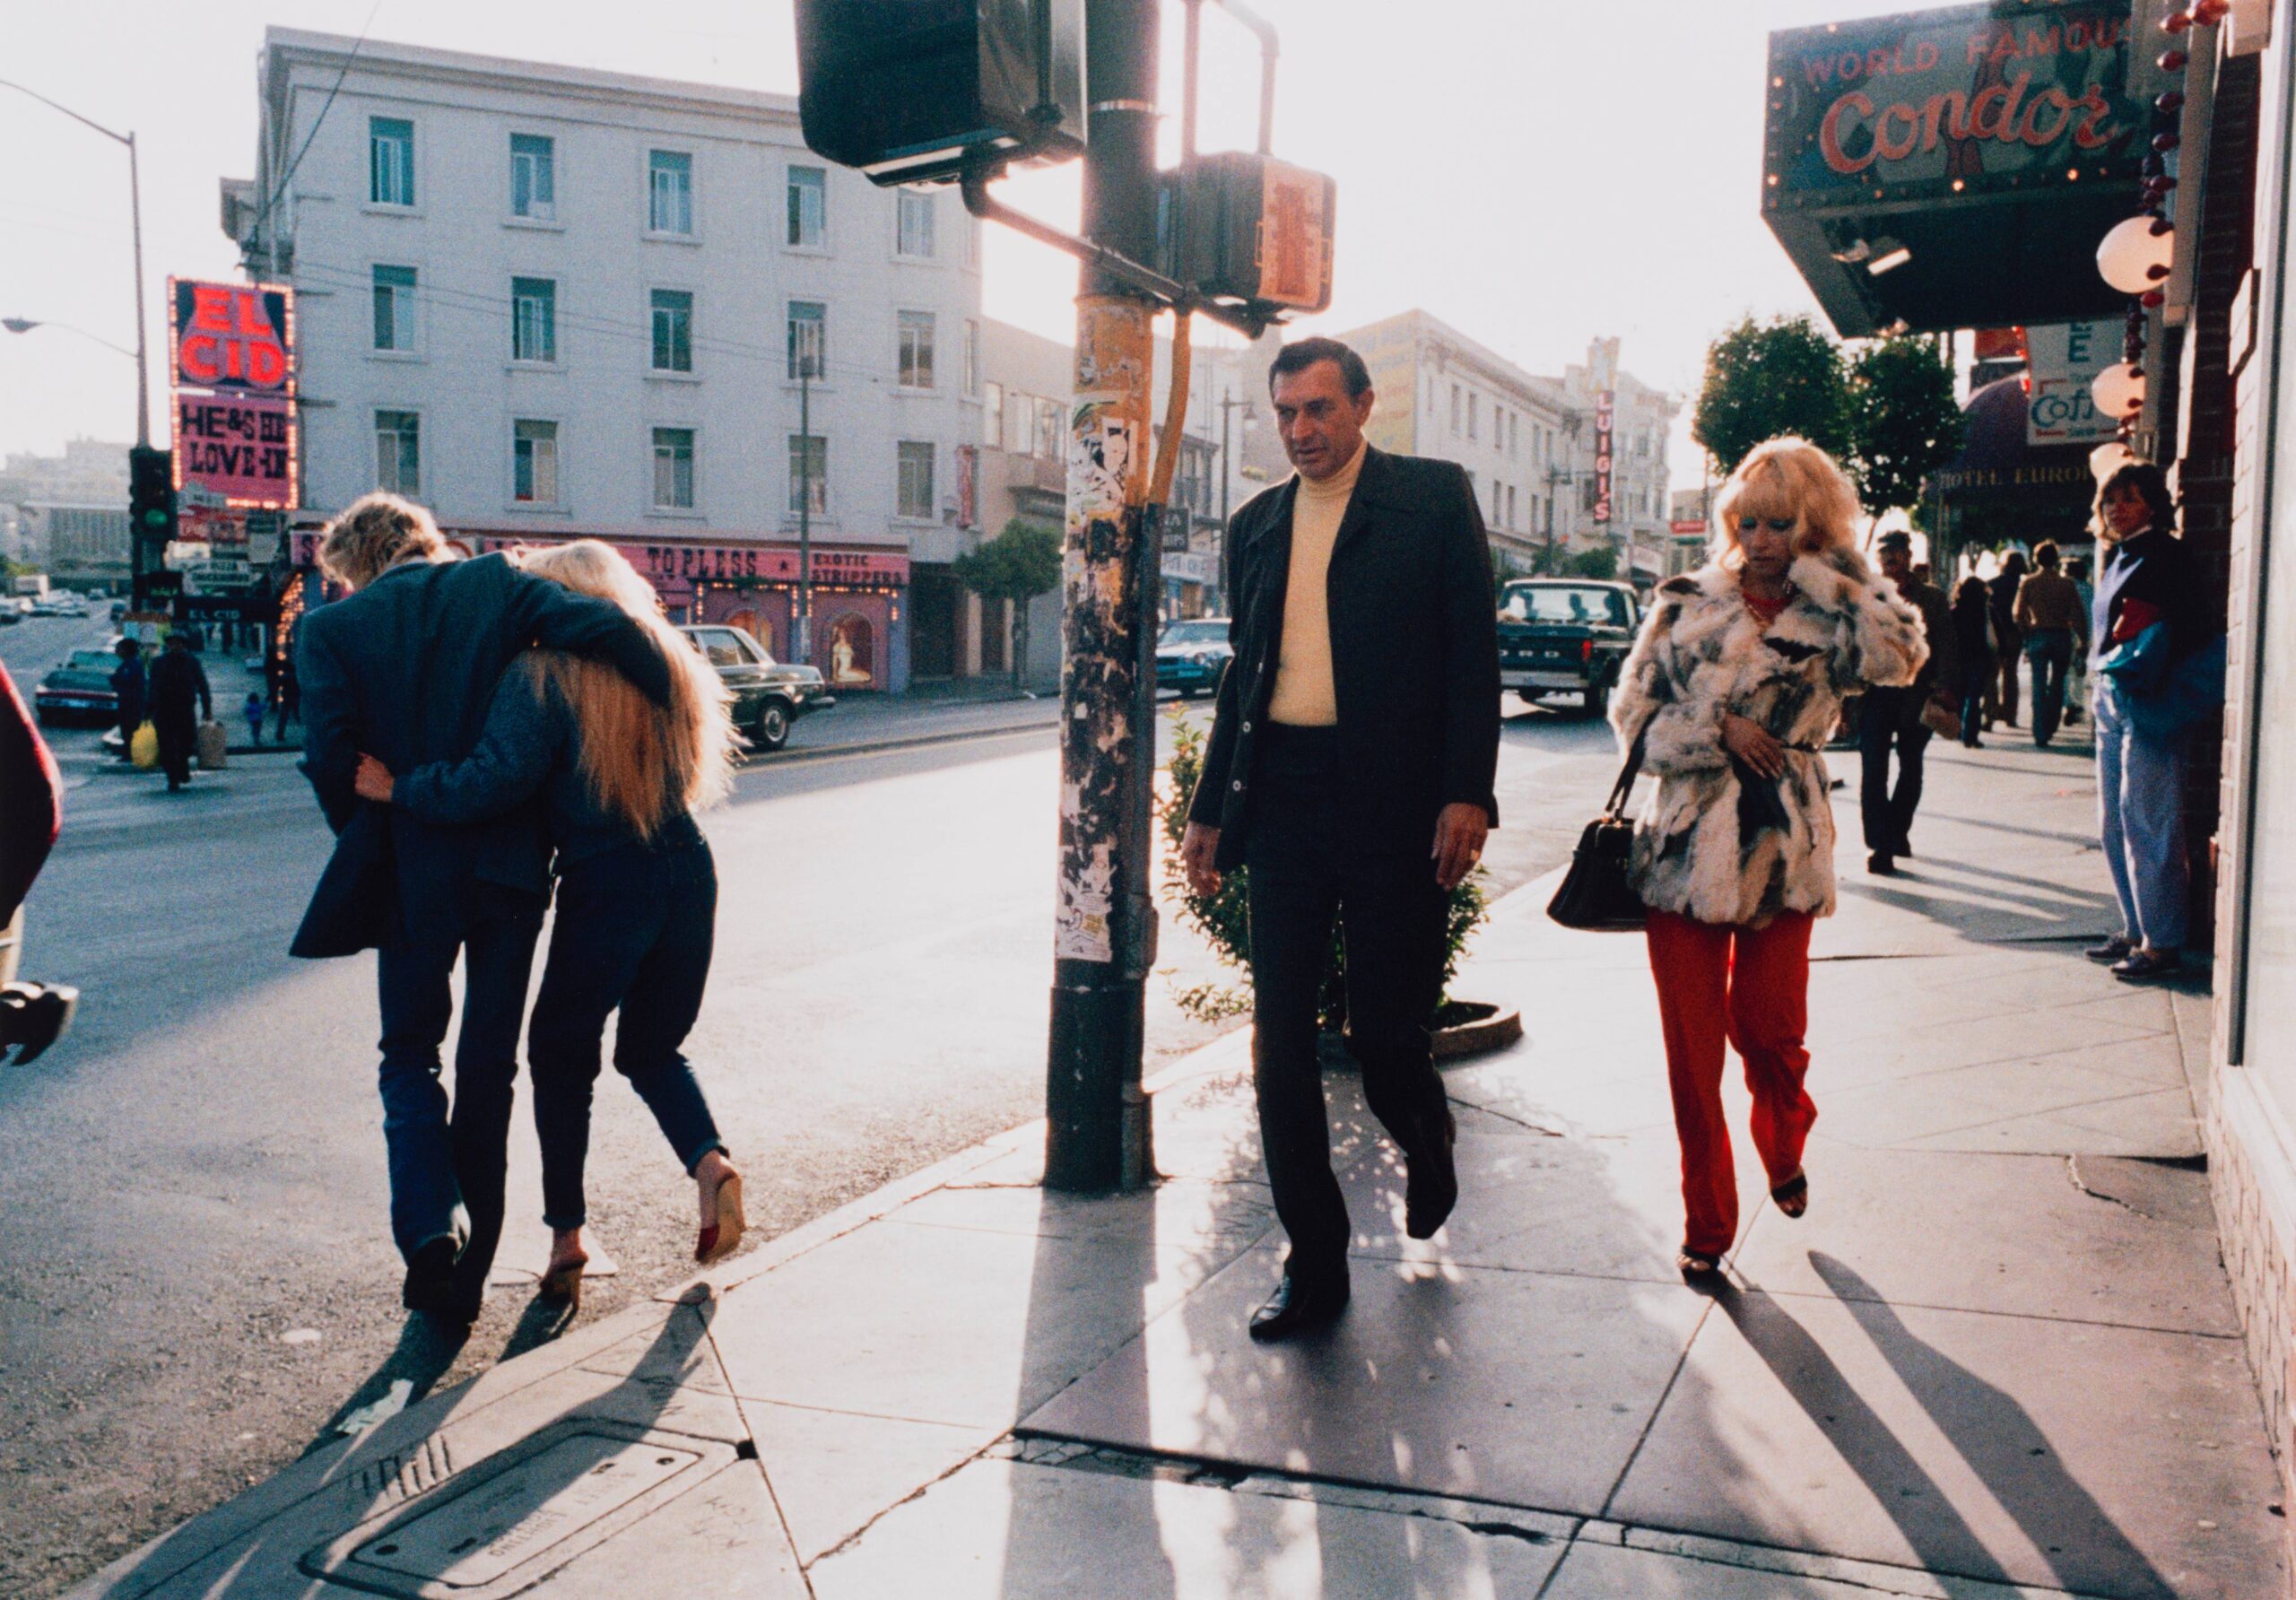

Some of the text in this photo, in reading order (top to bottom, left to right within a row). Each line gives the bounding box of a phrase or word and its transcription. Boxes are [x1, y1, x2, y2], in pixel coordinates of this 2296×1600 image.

[1802, 41, 1940, 84] WORLD
[1819, 71, 2119, 174] Condor
[193, 286, 273, 337] EL
[181, 335, 285, 384] CID
[2031, 387, 2095, 428] Coff
[1593, 391, 1613, 521] LUIGI'S
[648, 546, 757, 578] TOPLESS
[812, 569, 902, 583] STRIPPERS
[813, 552, 868, 567] EXOTIC
[1500, 649, 1561, 658] ORD
